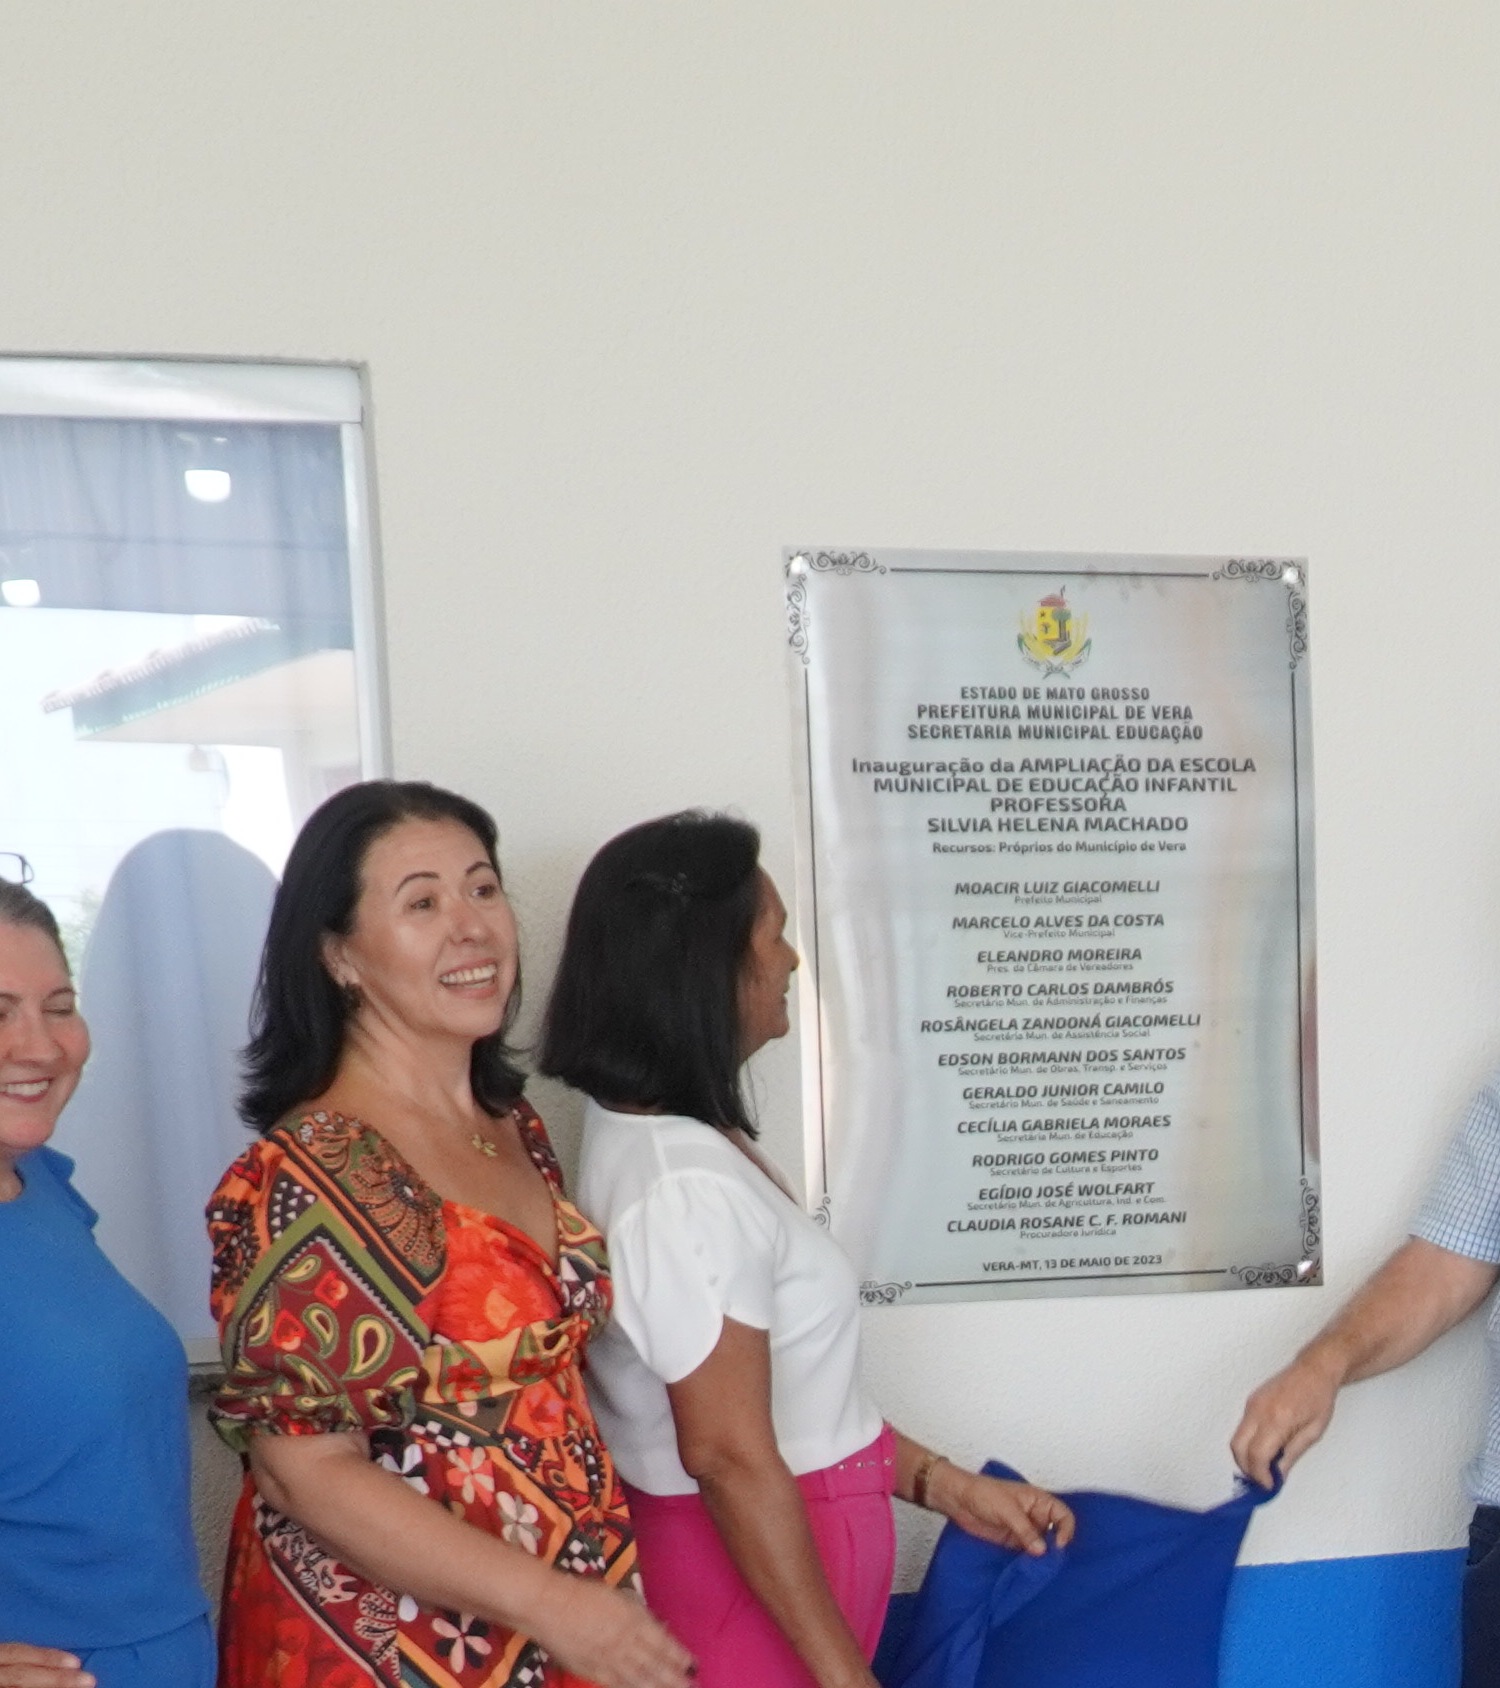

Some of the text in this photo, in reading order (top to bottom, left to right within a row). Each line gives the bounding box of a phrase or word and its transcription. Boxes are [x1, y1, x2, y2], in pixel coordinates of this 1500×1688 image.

[961, 687, 1149, 701] ESTADO DE MATO GROSSO
[917, 705, 1193, 720] PREFEITURA MUNICIPAL DE VERA
[908, 721, 1203, 743] SECRETARIA MUNICIPAL EDUCAÇÃO
[852, 758, 984, 776] Inauguração
[1020, 754, 1140, 777] AMPLIAÇÃO
[1148, 759, 1177, 773] DA
[1181, 758, 1257, 772] ESCOLA
[874, 772, 1237, 797] MUNICIPAL DE EDUCAÇÃO INFANTIL
[990, 797, 1127, 812] PROFESSORA
[927, 817, 1188, 833] SILVIA HELENA MACHADO
[933, 841, 1186, 856] Recursos: Próprios do Município de Vera
[955, 880, 1160, 894] MOACIR LUIZ GIACOMELLI
[1056, 895, 1102, 904] Municipal
[952, 914, 1164, 929] MARCELO ALVES DA COSTA
[1069, 929, 1115, 938] Municipal
[977, 948, 1142, 962] ELEANDRO MOREIRA
[947, 978, 1174, 997] ROBERTO CARLOS DAMBRÓS
[1033, 998, 1044, 1006] de
[921, 1014, 1201, 1032] ROSÂNGELA ZANDONÁ GIACOMELLI
[1052, 1031, 1063, 1039] de
[938, 1048, 1186, 1066] EDSON BORMANN DOS SANTOS
[1036, 1065, 1048, 1073] de
[962, 1082, 1164, 1100] GERALDO JUNIOR CAMILO
[1047, 1099, 1058, 1107] de
[957, 1115, 1172, 1133] CECÍLIA GABRIELA MORAES
[1075, 1132, 1087, 1140] de
[972, 1148, 1159, 1167] RODRIGO GOMES PINTO
[1042, 1166, 1053, 1174] de
[979, 1182, 1155, 1200] EGÍDIO JOSÉ WOLFART
[1045, 1200, 1056, 1208] de
[947, 1218, 1016, 1233] CLAUDIA
[1020, 1216, 1085, 1230] ROSANE
[1122, 1211, 1187, 1225] ROMANI
[1045, 1259, 1057, 1269] 13
[1060, 1258, 1076, 1268] DE
[1079, 1256, 1112, 1268] MAIO
[1114, 1256, 1130, 1266] DE
[1132, 1254, 1162, 1265] 2023
